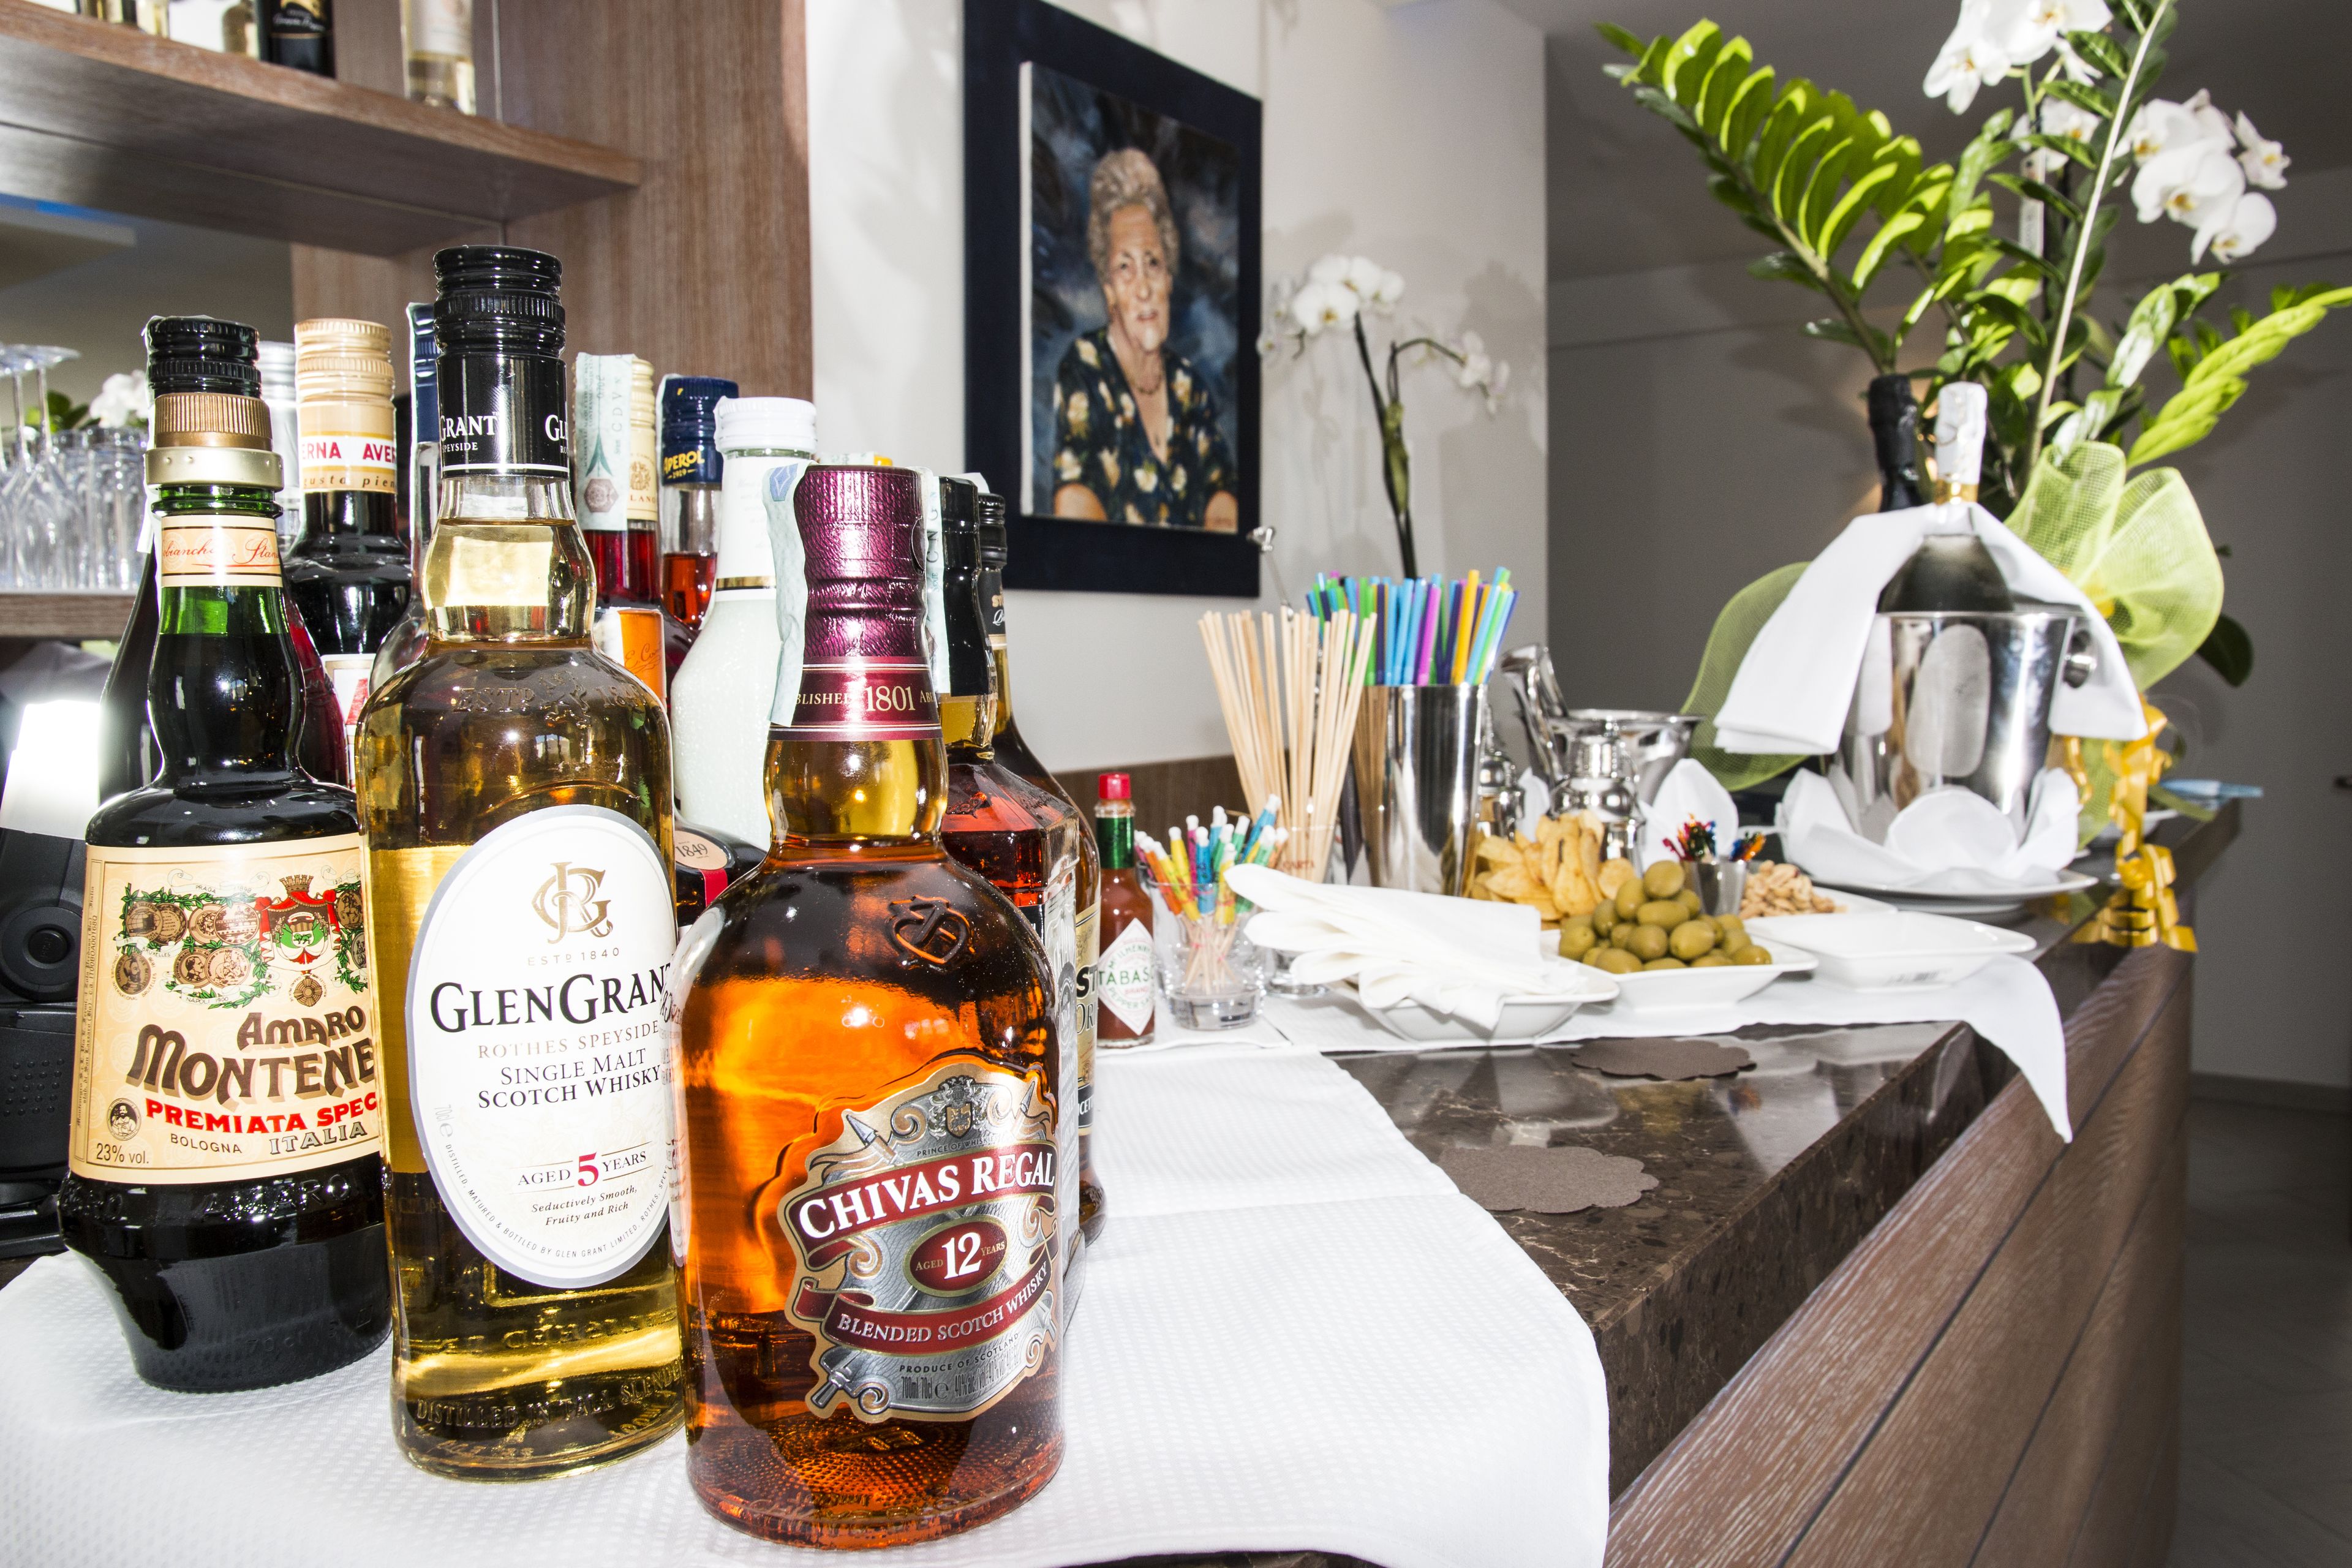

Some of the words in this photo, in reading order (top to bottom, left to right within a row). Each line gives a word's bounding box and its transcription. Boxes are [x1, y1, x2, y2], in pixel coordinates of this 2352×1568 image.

[440, 415, 498, 442] GRANT
[442, 441, 479, 453] SPEYSIDE
[865, 685, 916, 712] 1801
[675, 843, 708, 857] 1849
[196, 884, 216, 894] PRAGA
[581, 948, 620, 961] 1840
[237, 1005, 367, 1052] AMARO
[477, 1038, 568, 1059] ROTHES
[578, 1020, 660, 1050] SPEYSIDE
[501, 1061, 586, 1086] SINGLE
[592, 1048, 646, 1075] MALT
[478, 1084, 578, 1109] SCOTCH
[584, 1065, 661, 1097] WHISKY
[145, 1098, 306, 1134] PREMIATA
[96, 1142, 125, 1163] 23%
[128, 1152, 149, 1164] vol.
[171, 1133, 243, 1154] BOLOGNA
[270, 1121, 368, 1155] ITALIA
[917, 1145, 948, 1157] PRINCE
[518, 1169, 571, 1186] AGED
[577, 1152, 599, 1186] 5
[602, 1150, 647, 1172] YEARS
[531, 1194, 596, 1213] Seductively
[599, 1185, 638, 1202] Smooth,
[798, 1164, 962, 1239] CHIVAS
[971, 1151, 1055, 1196] REGAL
[467, 1189, 496, 1222] MATURED
[503, 1227, 538, 1251] BOTTLED
[581, 1244, 606, 1257] GRANT
[545, 1213, 581, 1226] Fruity
[584, 1205, 604, 1219] and
[608, 1202, 629, 1215] Rich
[915, 1259, 944, 1272] AGED
[941, 1232, 982, 1280] 12
[981, 1241, 1006, 1256] YEARS
[837, 1313, 932, 1343] BLENDED
[937, 1306, 1003, 1341] SCOTCH
[1006, 1263, 1049, 1317] WHISKY
[899, 1363, 952, 1374] PRODUCE
[957, 1359, 970, 1368] OF
[974, 1332, 1019, 1363] SCOTLAND
[901, 1376, 919, 1400] 700ml
[921, 1377, 933, 1400] 70cl
[417, 1397, 519, 1430] DISTILLED
[559, 1389, 616, 1420] TALL
